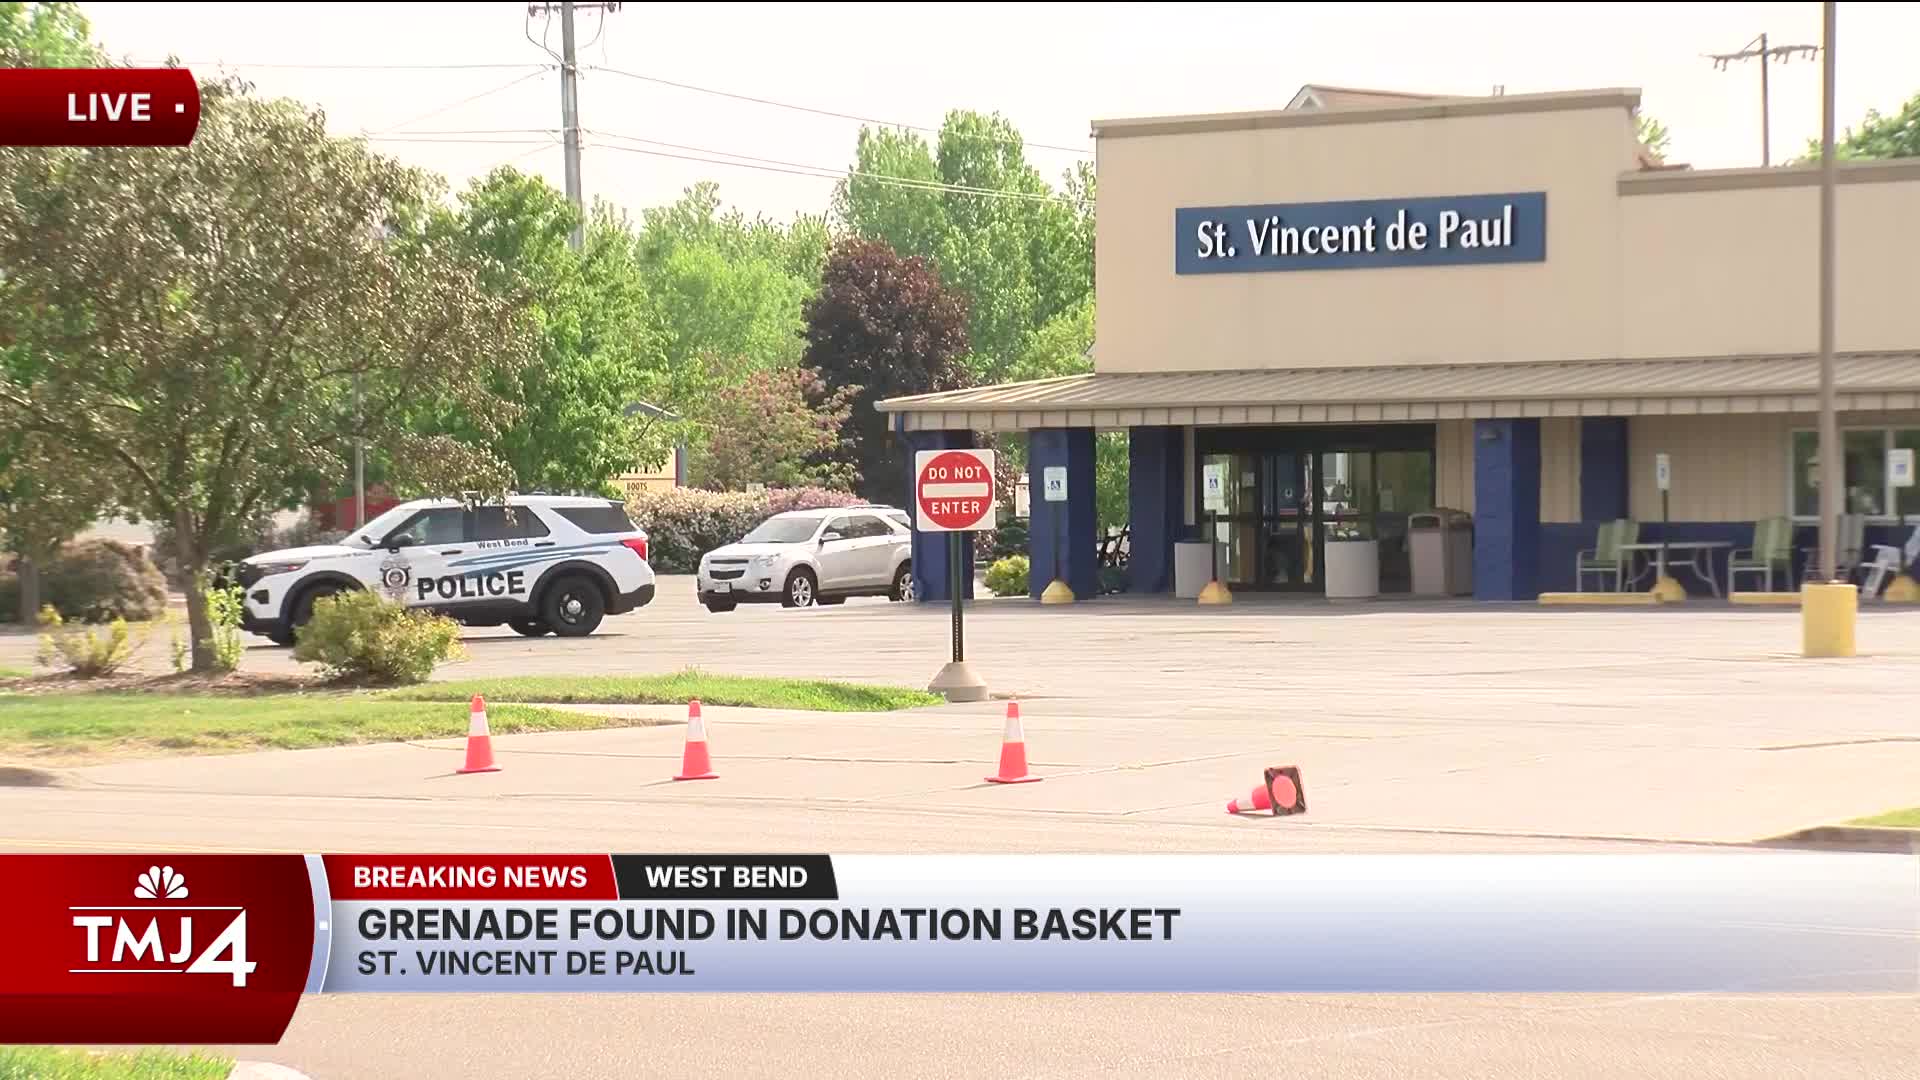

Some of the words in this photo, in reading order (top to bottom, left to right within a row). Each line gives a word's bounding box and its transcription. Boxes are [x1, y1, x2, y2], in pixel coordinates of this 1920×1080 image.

[1197, 219, 1236, 259] St.
[1246, 216, 1376, 256] Vincent
[1385, 210, 1428, 251] de
[1440, 204, 1513, 249] Paul
[928, 467, 947, 480] DO
[954, 466, 982, 479] NOT
[931, 501, 980, 515] ENTER
[478, 541, 502, 550] West
[504, 538, 529, 548] Bend
[417, 570, 526, 601] POLICE
